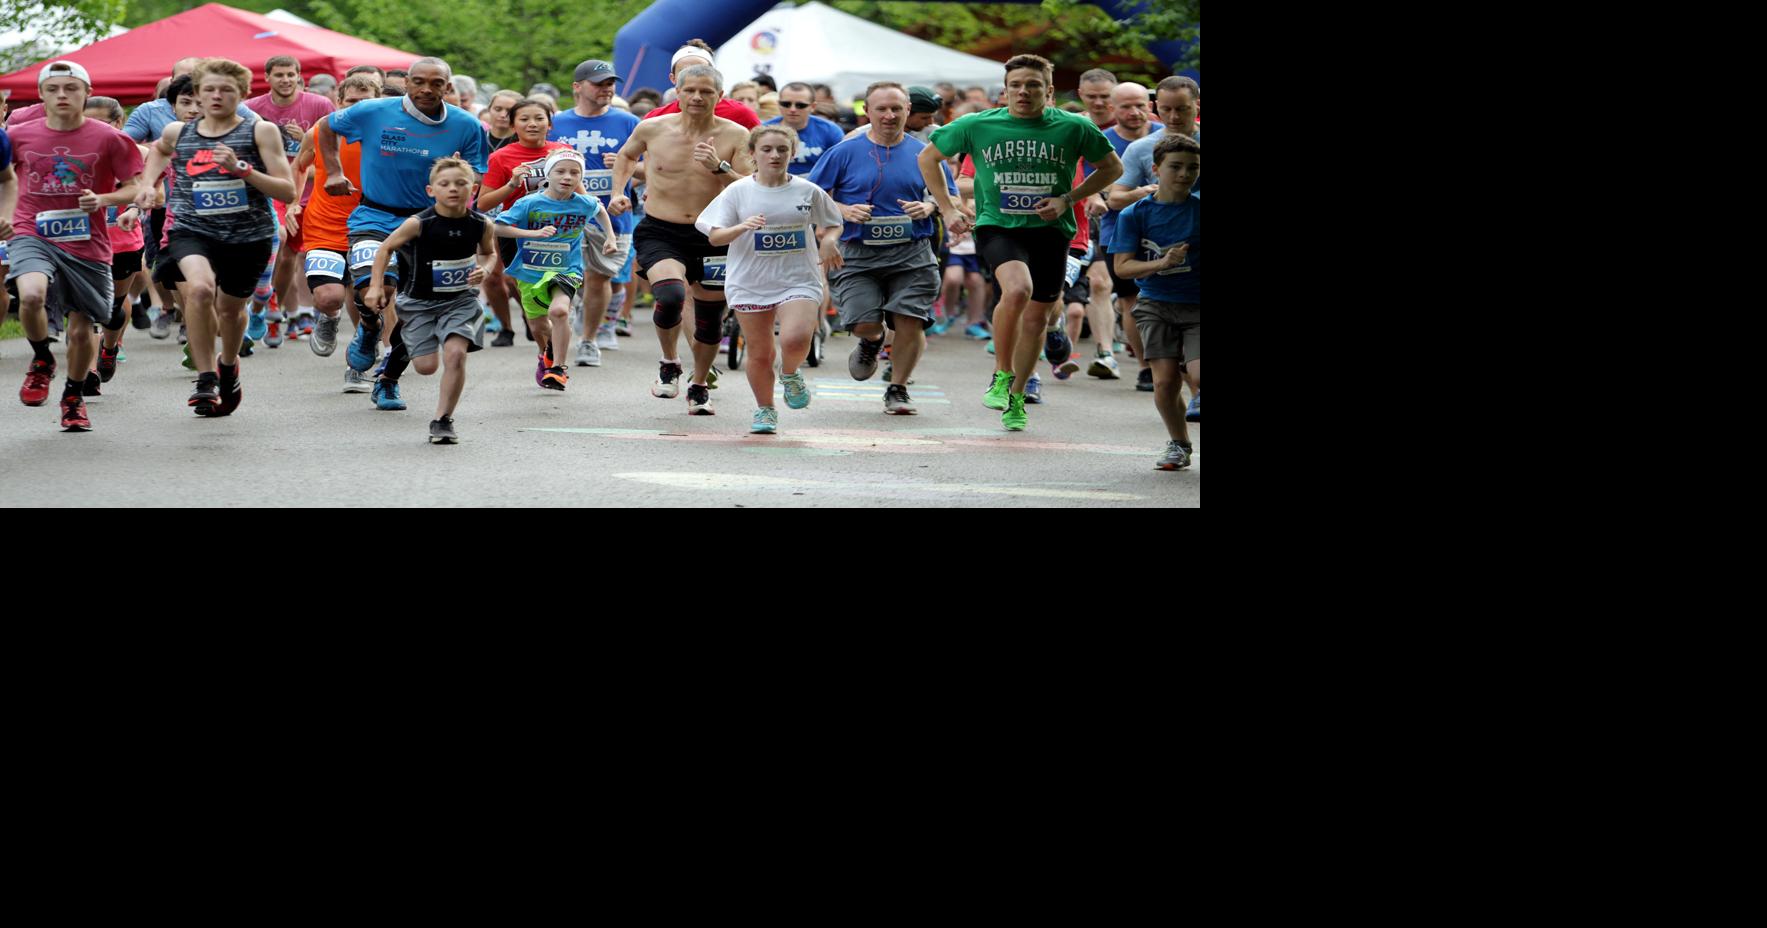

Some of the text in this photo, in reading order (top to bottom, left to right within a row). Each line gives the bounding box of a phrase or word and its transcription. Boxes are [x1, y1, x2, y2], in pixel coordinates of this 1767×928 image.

[381, 133, 406, 142] GLASS
[380, 145, 423, 155] MARATHON
[982, 140, 1066, 164] MARSHALL
[993, 172, 1058, 185] MEDICINE
[201, 191, 240, 207] 335
[39, 218, 87, 236] 1044
[871, 225, 905, 238] 999
[762, 234, 797, 249] 994
[308, 258, 338, 270] 707
[529, 251, 562, 265] 776
